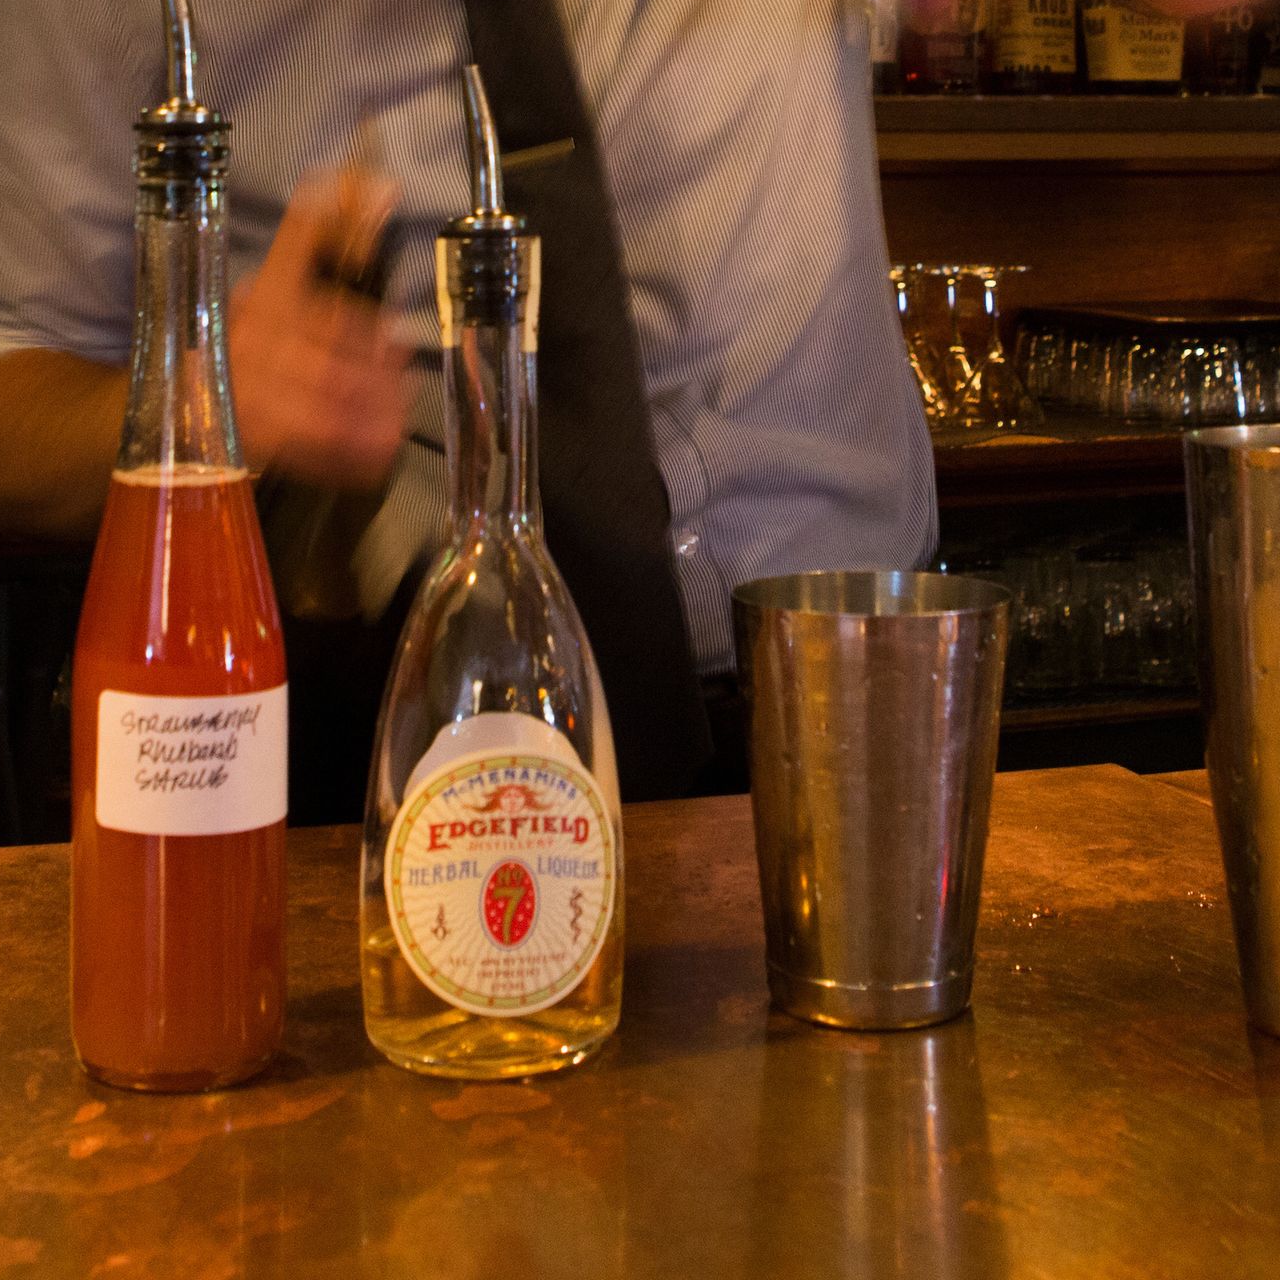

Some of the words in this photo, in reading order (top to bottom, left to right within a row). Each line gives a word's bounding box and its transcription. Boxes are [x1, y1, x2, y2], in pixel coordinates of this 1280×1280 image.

[427, 815, 590, 852] EDGEFIELD
[408, 860, 483, 886] HERBAL
[536, 854, 600, 879] LIQUEUR
[493, 886, 525, 946] 7
